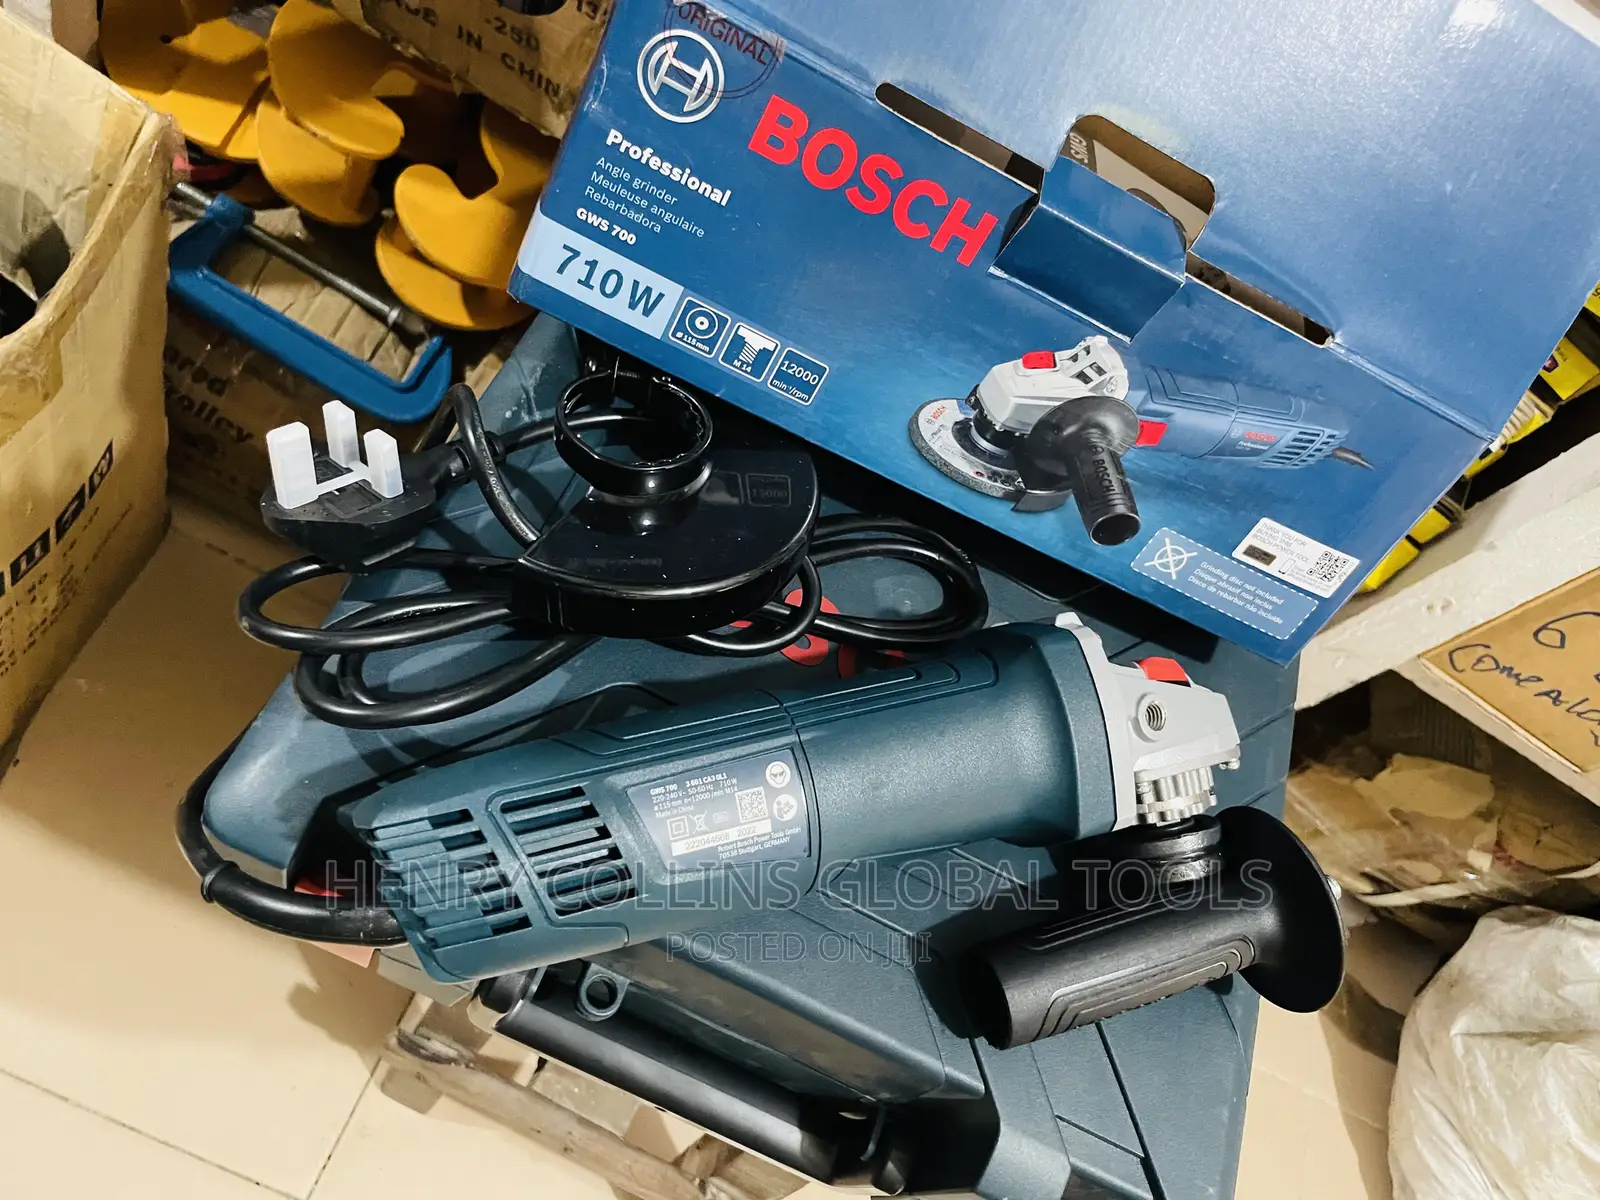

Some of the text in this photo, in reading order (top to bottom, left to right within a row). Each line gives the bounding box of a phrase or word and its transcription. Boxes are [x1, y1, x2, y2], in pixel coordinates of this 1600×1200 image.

[678, 3, 767, 66] ORIGINAL
[457, 24, 568, 103] IN CHIN
[596, 156, 678, 205] Angle grinder
[605, 128, 732, 207] Professional
[747, 94, 999, 267] BOSCH
[584, 185, 662, 234] Rebarbadora
[590, 170, 705, 238] Meuleuse angulaire
[576, 207, 637, 246] GWS 700
[556, 243, 666, 319] 710 W
[732, 359, 752, 373] M 14
[780, 360, 819, 386] 12000
[1091, 457, 1117, 495] BOSCH
[1187, 575, 1208, 589] Disco
[1207, 583, 1217, 593] de
[1216, 588, 1245, 607] rebarbar
[1194, 568, 1274, 610] Disque abrasif non inclus
[1200, 561, 1285, 605] Grinding disc not included
[650, 785, 666, 796] GWS
[665, 783, 678, 793] 700
[719, 780, 732, 788] 710
[717, 825, 802, 853] Robert Bosch Power Tools GmbH
[737, 825, 757, 838] 2022
[763, 836, 791, 849] GERMANY
